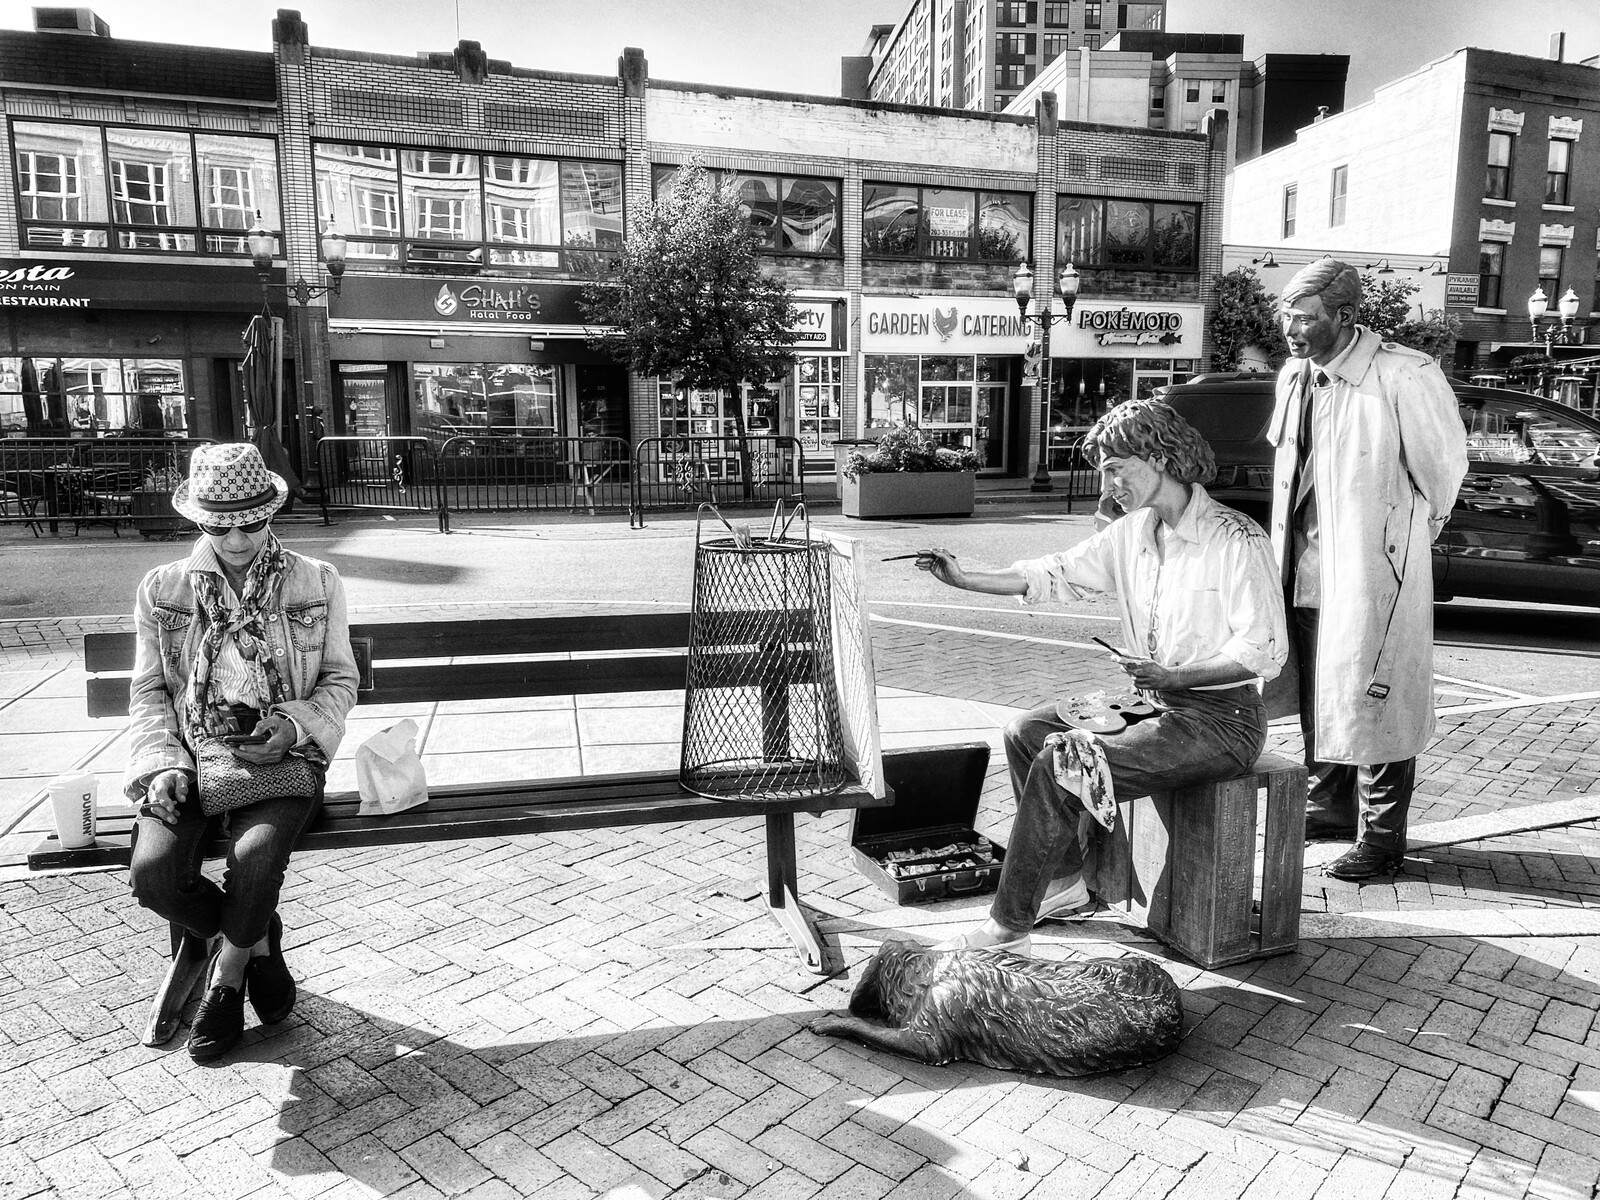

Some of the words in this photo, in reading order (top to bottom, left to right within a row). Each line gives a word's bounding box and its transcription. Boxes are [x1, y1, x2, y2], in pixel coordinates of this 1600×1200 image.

[931, 208, 944, 217] FOR
[946, 209, 967, 218] LEASE
[470, 311, 499, 319] Halal
[506, 312, 532, 320] Food
[793, 308, 825, 329] ety
[869, 312, 929, 335] GARDEN
[963, 315, 1032, 336] CATERING
[1080, 307, 1182, 331] POKÉMOTO
[814, 333, 826, 341] AIDS
[83, 792, 91, 836] DUNKIN'
